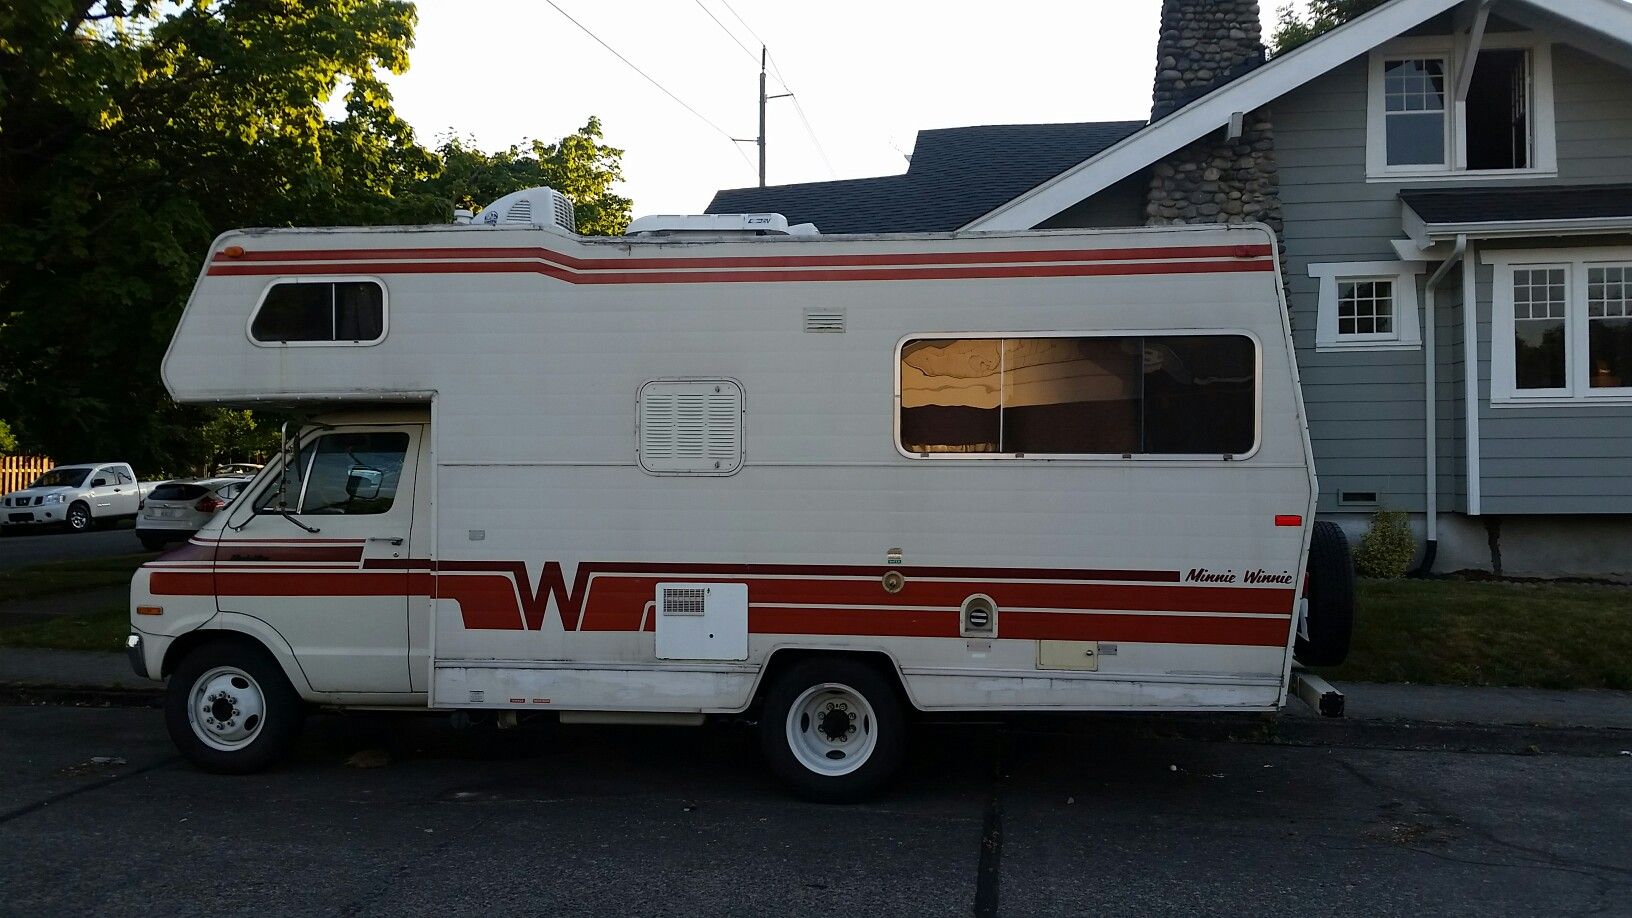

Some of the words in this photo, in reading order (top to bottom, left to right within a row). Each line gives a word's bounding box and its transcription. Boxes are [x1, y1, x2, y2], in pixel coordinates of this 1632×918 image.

[513, 561, 591, 631] W
[1185, 568, 1237, 583] Minnie
[1243, 569, 1292, 584] Winnie
